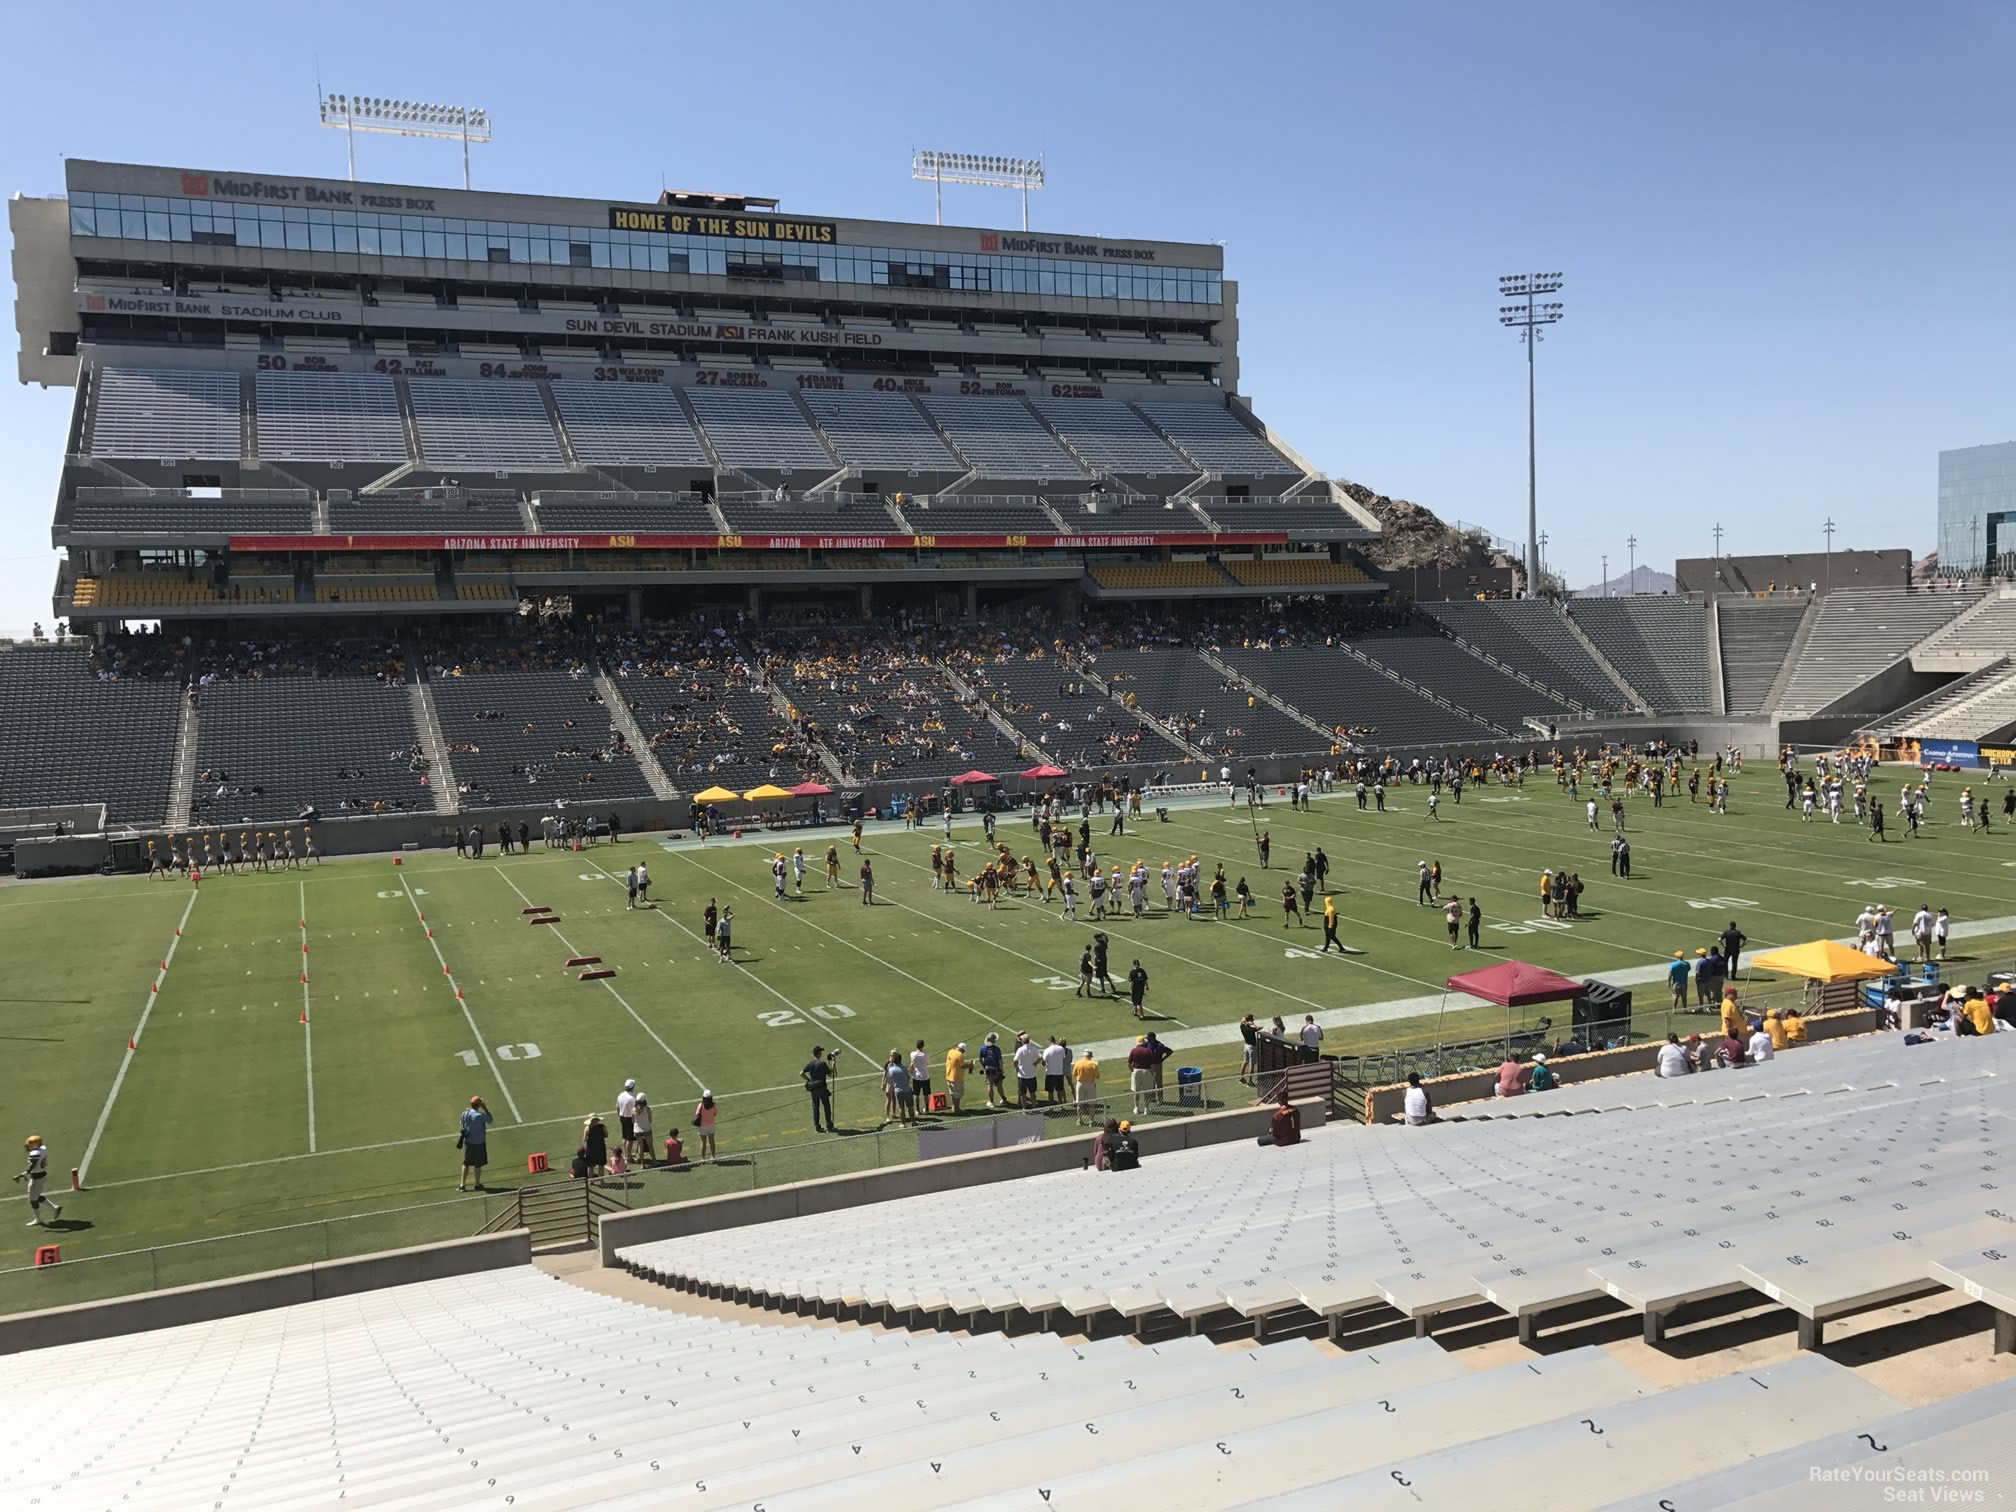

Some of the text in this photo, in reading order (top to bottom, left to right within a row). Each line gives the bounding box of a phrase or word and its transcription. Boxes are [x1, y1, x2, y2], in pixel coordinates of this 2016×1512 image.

[304, 185, 354, 205] BANK
[360, 194, 403, 209] PRESS
[405, 198, 436, 212] BOX
[615, 211, 832, 242] HOME OF THE SUN DEVILS
[1064, 242, 1098, 257] BANK
[1102, 247, 1132, 259] PRESS
[1134, 249, 1155, 261] BOX
[175, 301, 211, 315] BANK
[221, 305, 294, 319] STADIUM
[298, 309, 342, 321] CLUB
[566, 319, 882, 346] SUN DEVIL STADIUM ASU FRANK KUSH FIELD
[257, 354, 287, 371] 50
[374, 359, 402, 375] 42
[415, 360, 434, 368] PAT
[480, 362, 506, 378] 84
[594, 367, 618, 381] 33
[619, 367, 665, 376] WILFORD
[727, 371, 760, 380] BOBBY
[696, 370, 719, 386] 27
[796, 374, 812, 389] 11
[873, 377, 897, 392] 40
[960, 381, 981, 395] 52
[1051, 384, 1072, 398] 62
[444, 538, 579, 549] ARIZONA STATE UNIVERSITY
[609, 535, 635, 547] ASU
[718, 535, 743, 547] ASU
[836, 538, 886, 549] UNIVERSITY
[913, 535, 936, 547] ASU
[1006, 535, 1027, 547] ASU
[1054, 536, 1154, 548] ARIZONA STATE UNIVERSITY
[1843, 876, 1927, 889] 30
[1685, 897, 1760, 909] 40
[1486, 918, 1574, 934] 50
[756, 1004, 857, 1028] 20
[454, 1043, 542, 1067] 10
[934, 1095, 947, 1110] 20
[532, 1155, 546, 1171] 10
[41, 1248, 55, 1265] G
[1786, 1255, 1809, 1266] 30
[1981, 1249, 2008, 1261] 30
[1627, 1260, 1648, 1269] 30
[1321, 1274, 1336, 1282] 30
[1410, 1272, 1426, 1280] 30
[1509, 1267, 1527, 1277] 30
[1243, 1279, 1257, 1287] 30
[863, 1359, 871, 1367] 2
[911, 1362, 921, 1371] 2
[967, 1370, 977, 1379] 2
[1038, 1372, 1049, 1381] 2
[1124, 1380, 1137, 1390] 2
[1230, 1387, 1245, 1399] 2
[858, 1395, 867, 1404] 3
[916, 1399, 927, 1409] 3
[1377, 1400, 1397, 1413] 2
[989, 1411, 1001, 1422] 3
[1085, 1422, 1099, 1435] 3
[1580, 1419, 1604, 1435] 2
[1215, 1442, 1232, 1455] 3
[1856, 1433, 1888, 1452] 2
[1390, 1470, 1412, 1487] 3
